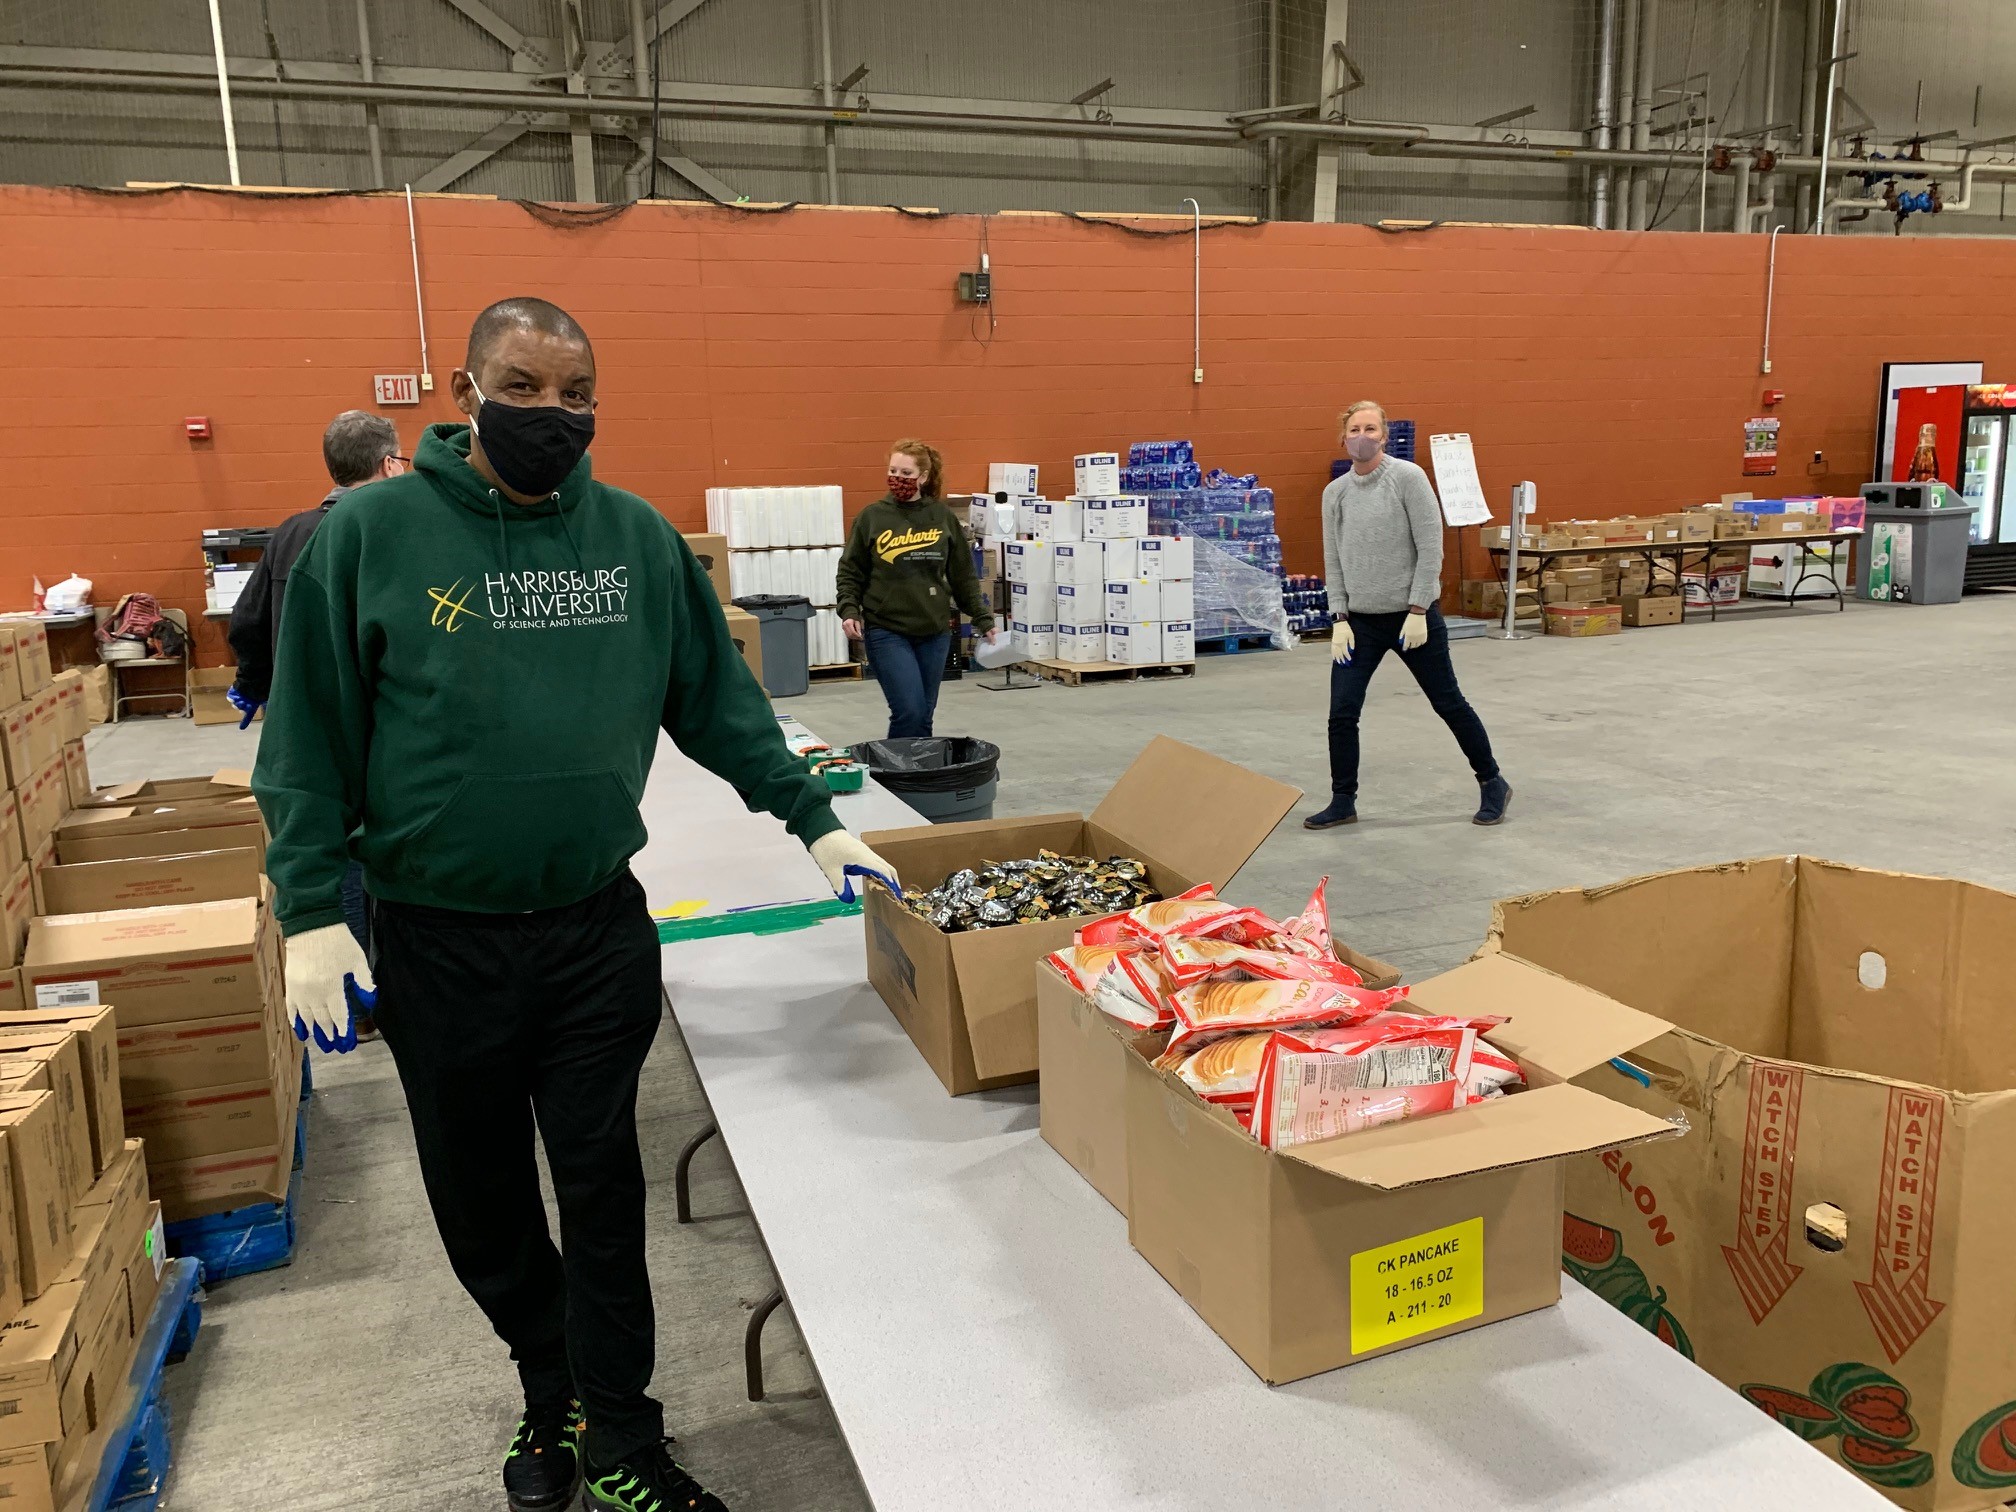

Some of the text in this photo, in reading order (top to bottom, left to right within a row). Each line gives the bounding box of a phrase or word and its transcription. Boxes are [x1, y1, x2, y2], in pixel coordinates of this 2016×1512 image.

[382, 378, 412, 401] EXIT
[1094, 457, 1112, 465] ULINE
[876, 527, 943, 554] Carhartt
[485, 566, 628, 594] HARRISBURG
[488, 590, 628, 618] UNIVERSITY
[493, 614, 629, 630] OF SCIENCE AND TECHNOLOGY
[1033, 625, 1052, 633] ULINE
[1082, 626, 1101, 634] ULINE
[1433, 1069, 1441, 1082] 180
[1319, 1098, 1329, 1108] 3.
[1341, 1097, 1350, 1107] 2.
[1361, 1095, 1371, 1105] 1.
[1756, 1070, 1789, 1238] WATCH STEP
[1893, 1099, 1929, 1273] WATCH STEP
[1377, 1238, 1460, 1274] CK PANCAKE
[1385, 1284, 1399, 1299] 18
[1410, 1273, 1434, 1291] 16.5
[1437, 1267, 1454, 1283] OZ
[1387, 1311, 1396, 1325] A
[1407, 1300, 1427, 1318] 211
[1438, 1293, 1452, 1308] 20
